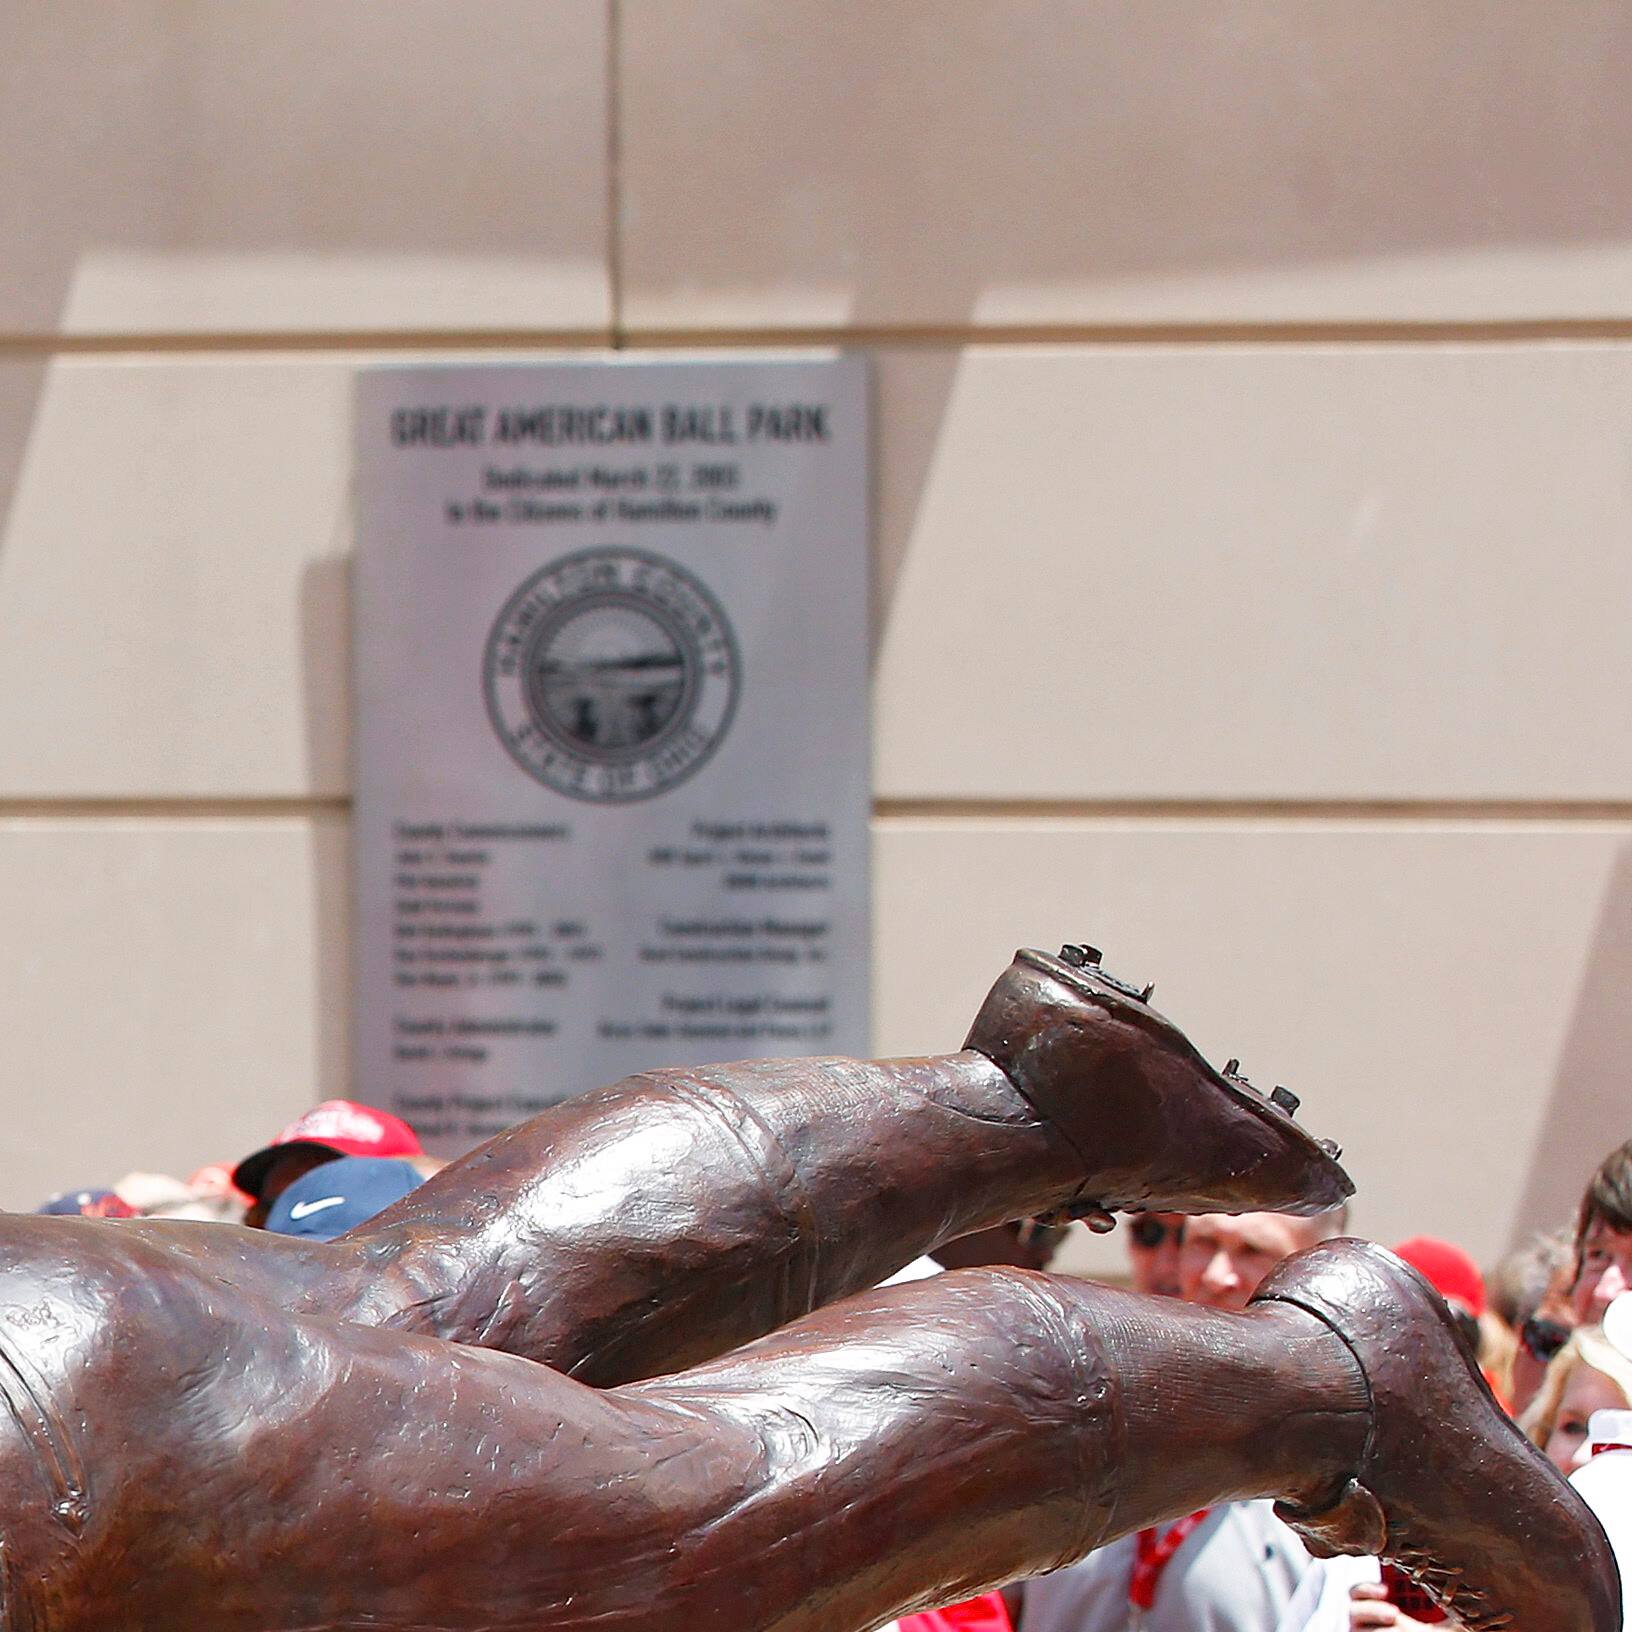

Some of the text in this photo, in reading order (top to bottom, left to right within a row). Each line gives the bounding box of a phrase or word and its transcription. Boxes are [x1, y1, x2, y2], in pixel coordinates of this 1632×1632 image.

[391, 401, 831, 448] GREAT AMERICAN BALL PARK
